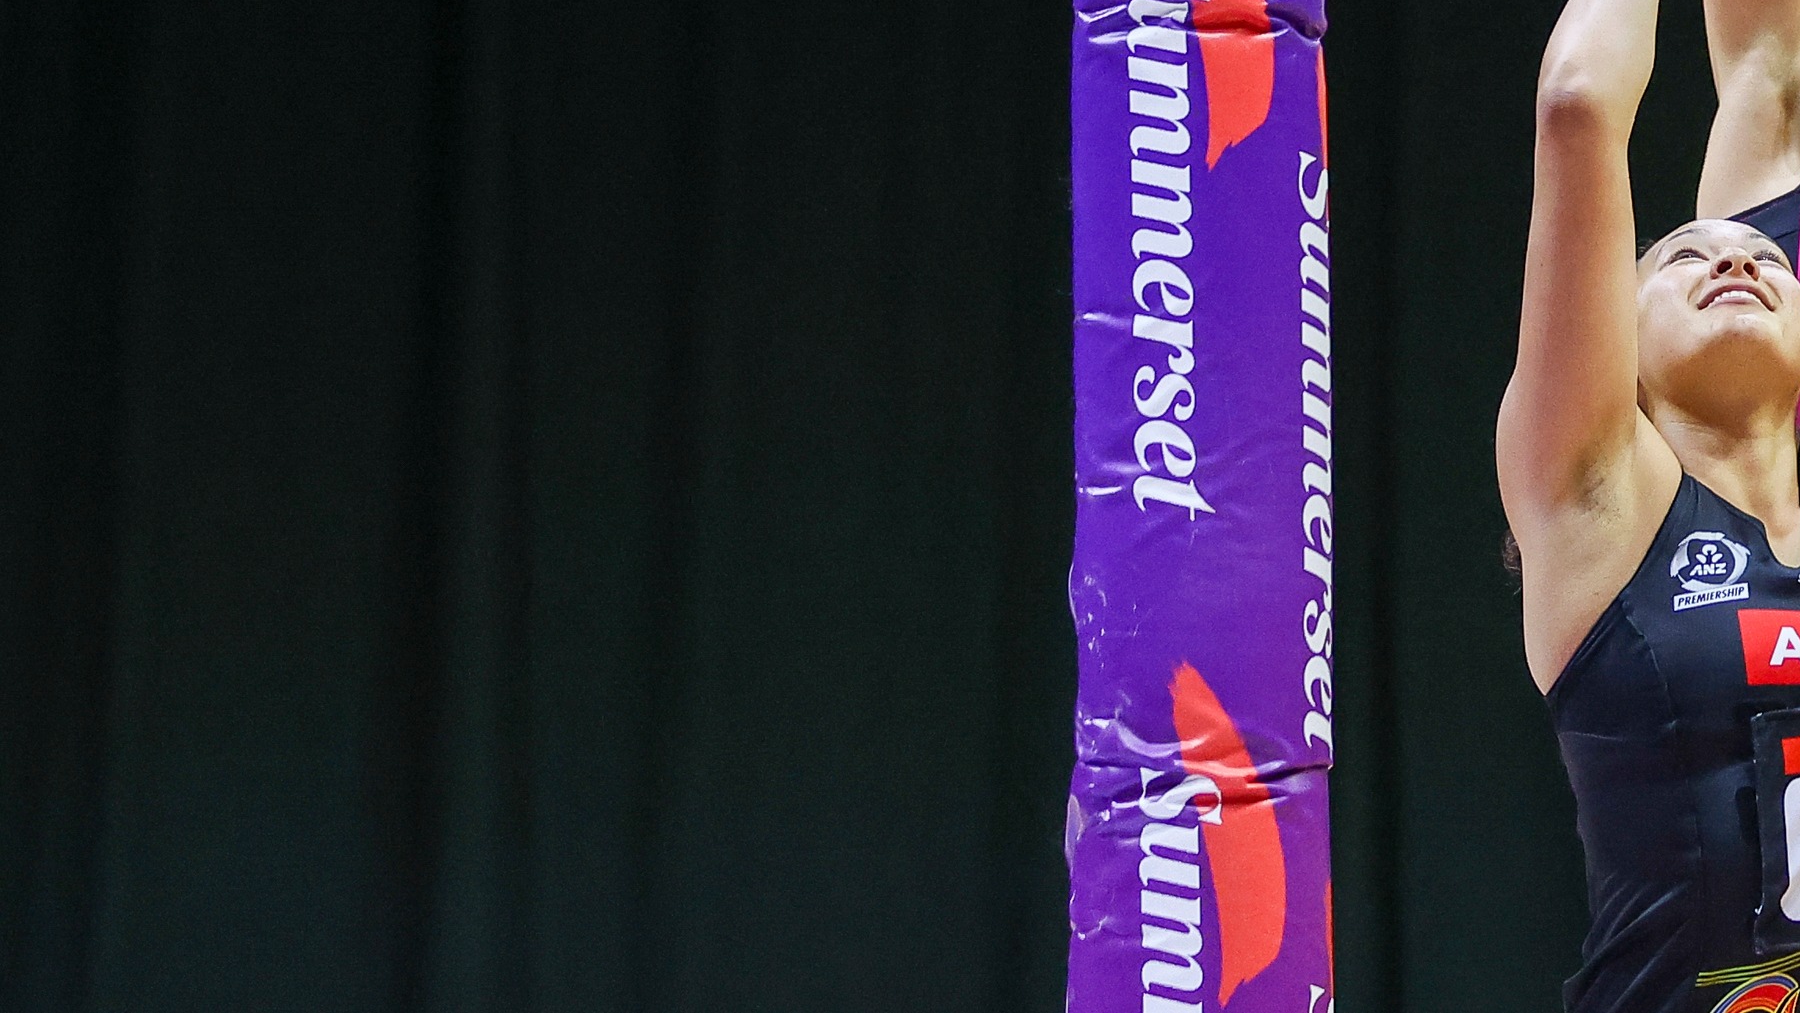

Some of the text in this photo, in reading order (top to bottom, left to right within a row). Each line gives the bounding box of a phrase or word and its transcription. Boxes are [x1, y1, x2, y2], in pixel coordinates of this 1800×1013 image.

[1690, 562, 1727, 577] ANZ
[1677, 586, 1745, 608] PREMIERSHIP
[1138, 768, 1224, 1013] Sum
